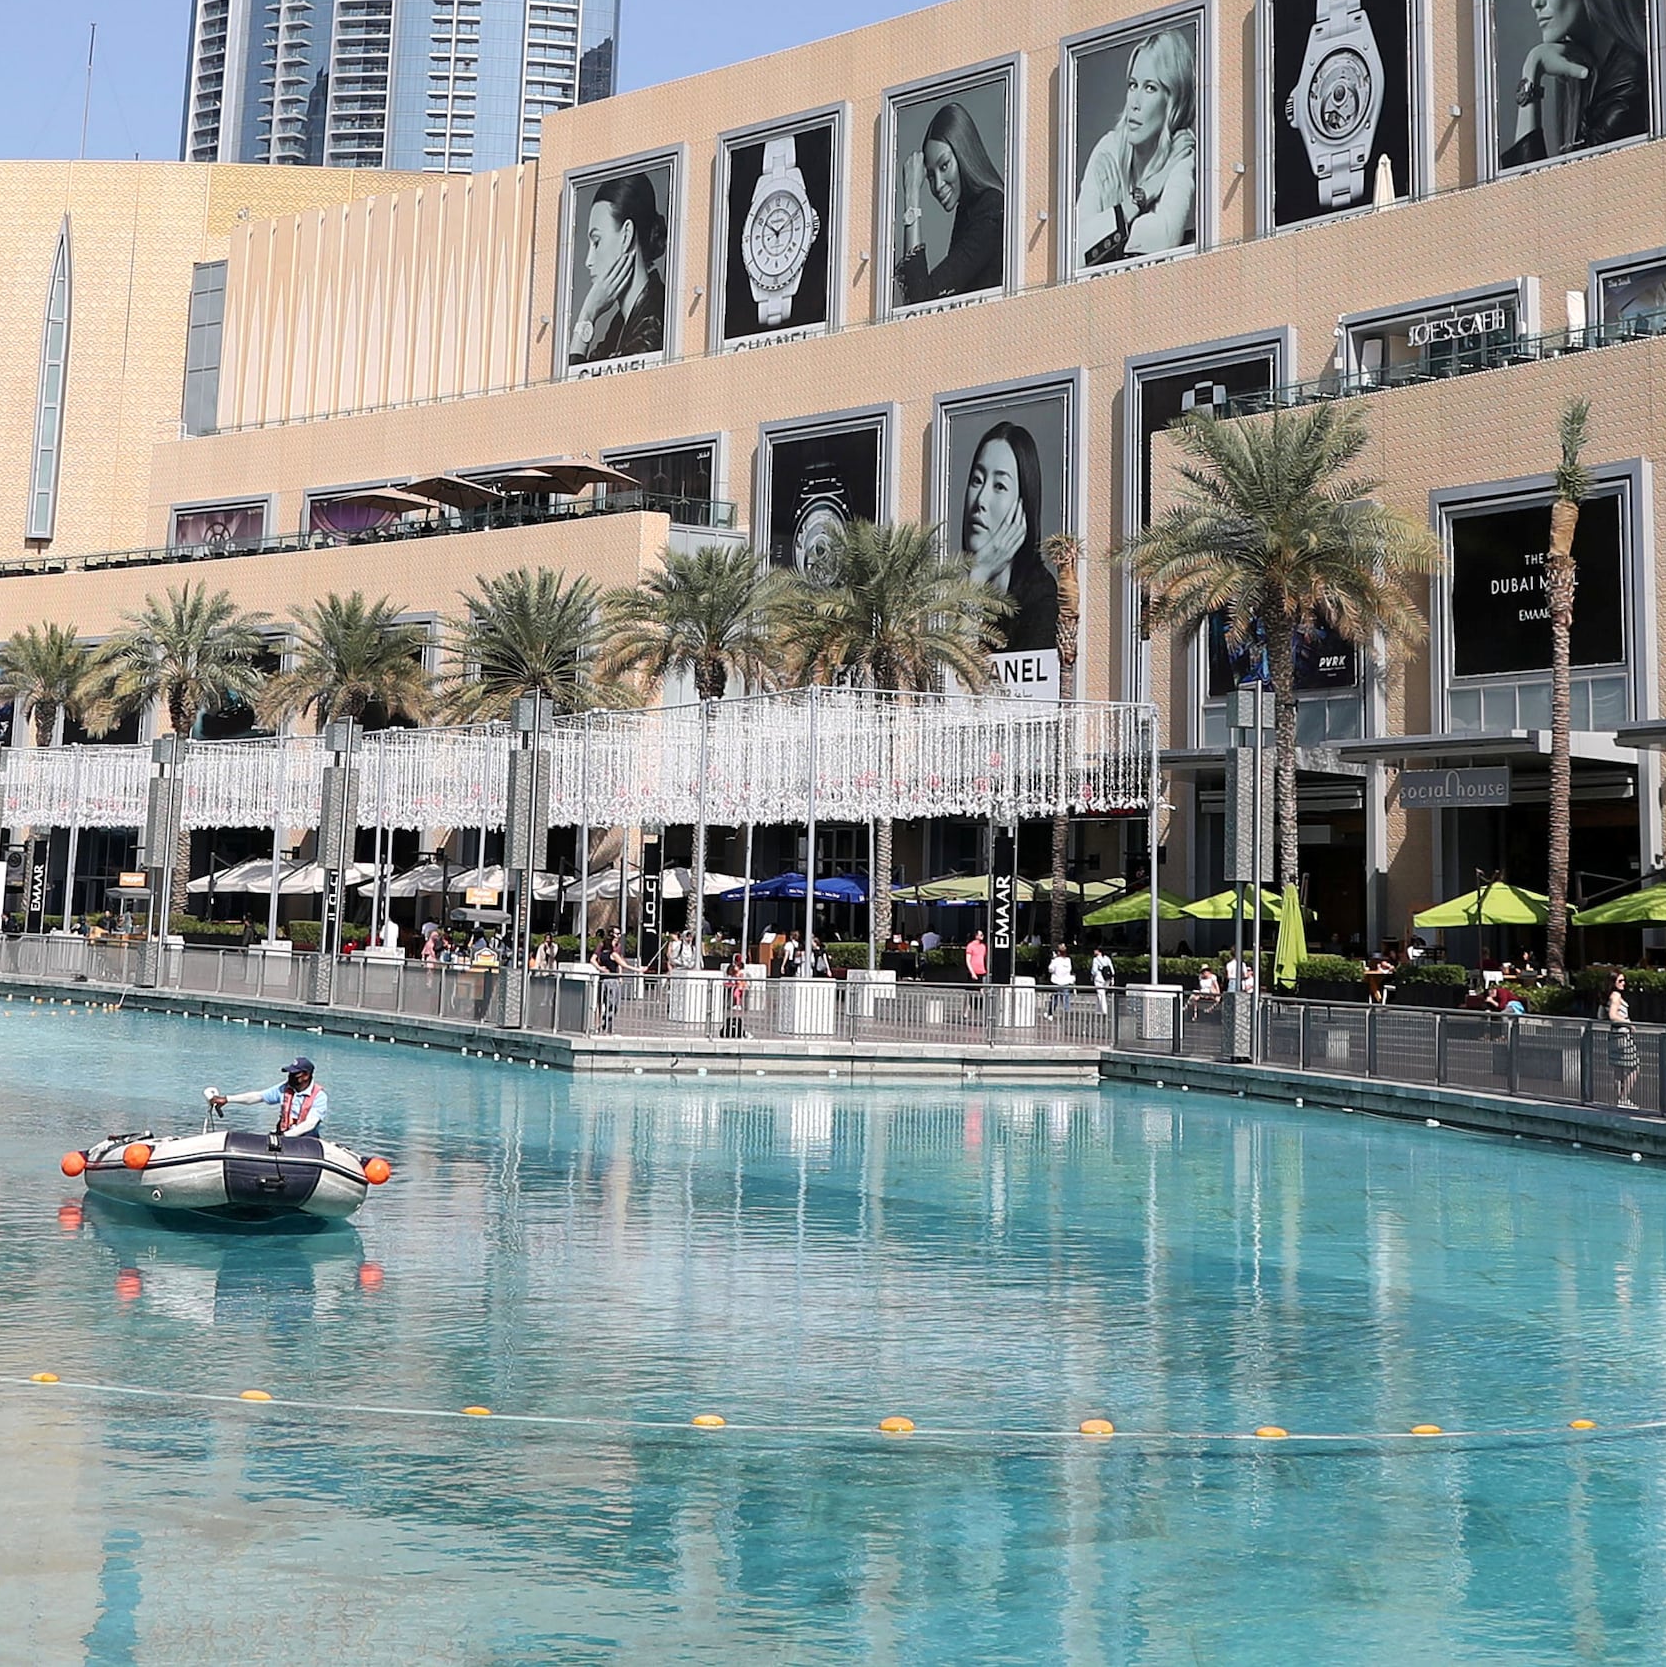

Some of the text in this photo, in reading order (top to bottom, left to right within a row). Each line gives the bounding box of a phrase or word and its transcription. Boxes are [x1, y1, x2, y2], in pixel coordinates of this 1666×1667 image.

[1524, 553, 1545, 565] THE
[1491, 571, 1579, 595] DUBAI ML
[30, 864, 44, 911] EMAAR
[994, 875, 1011, 948] EMAAR
